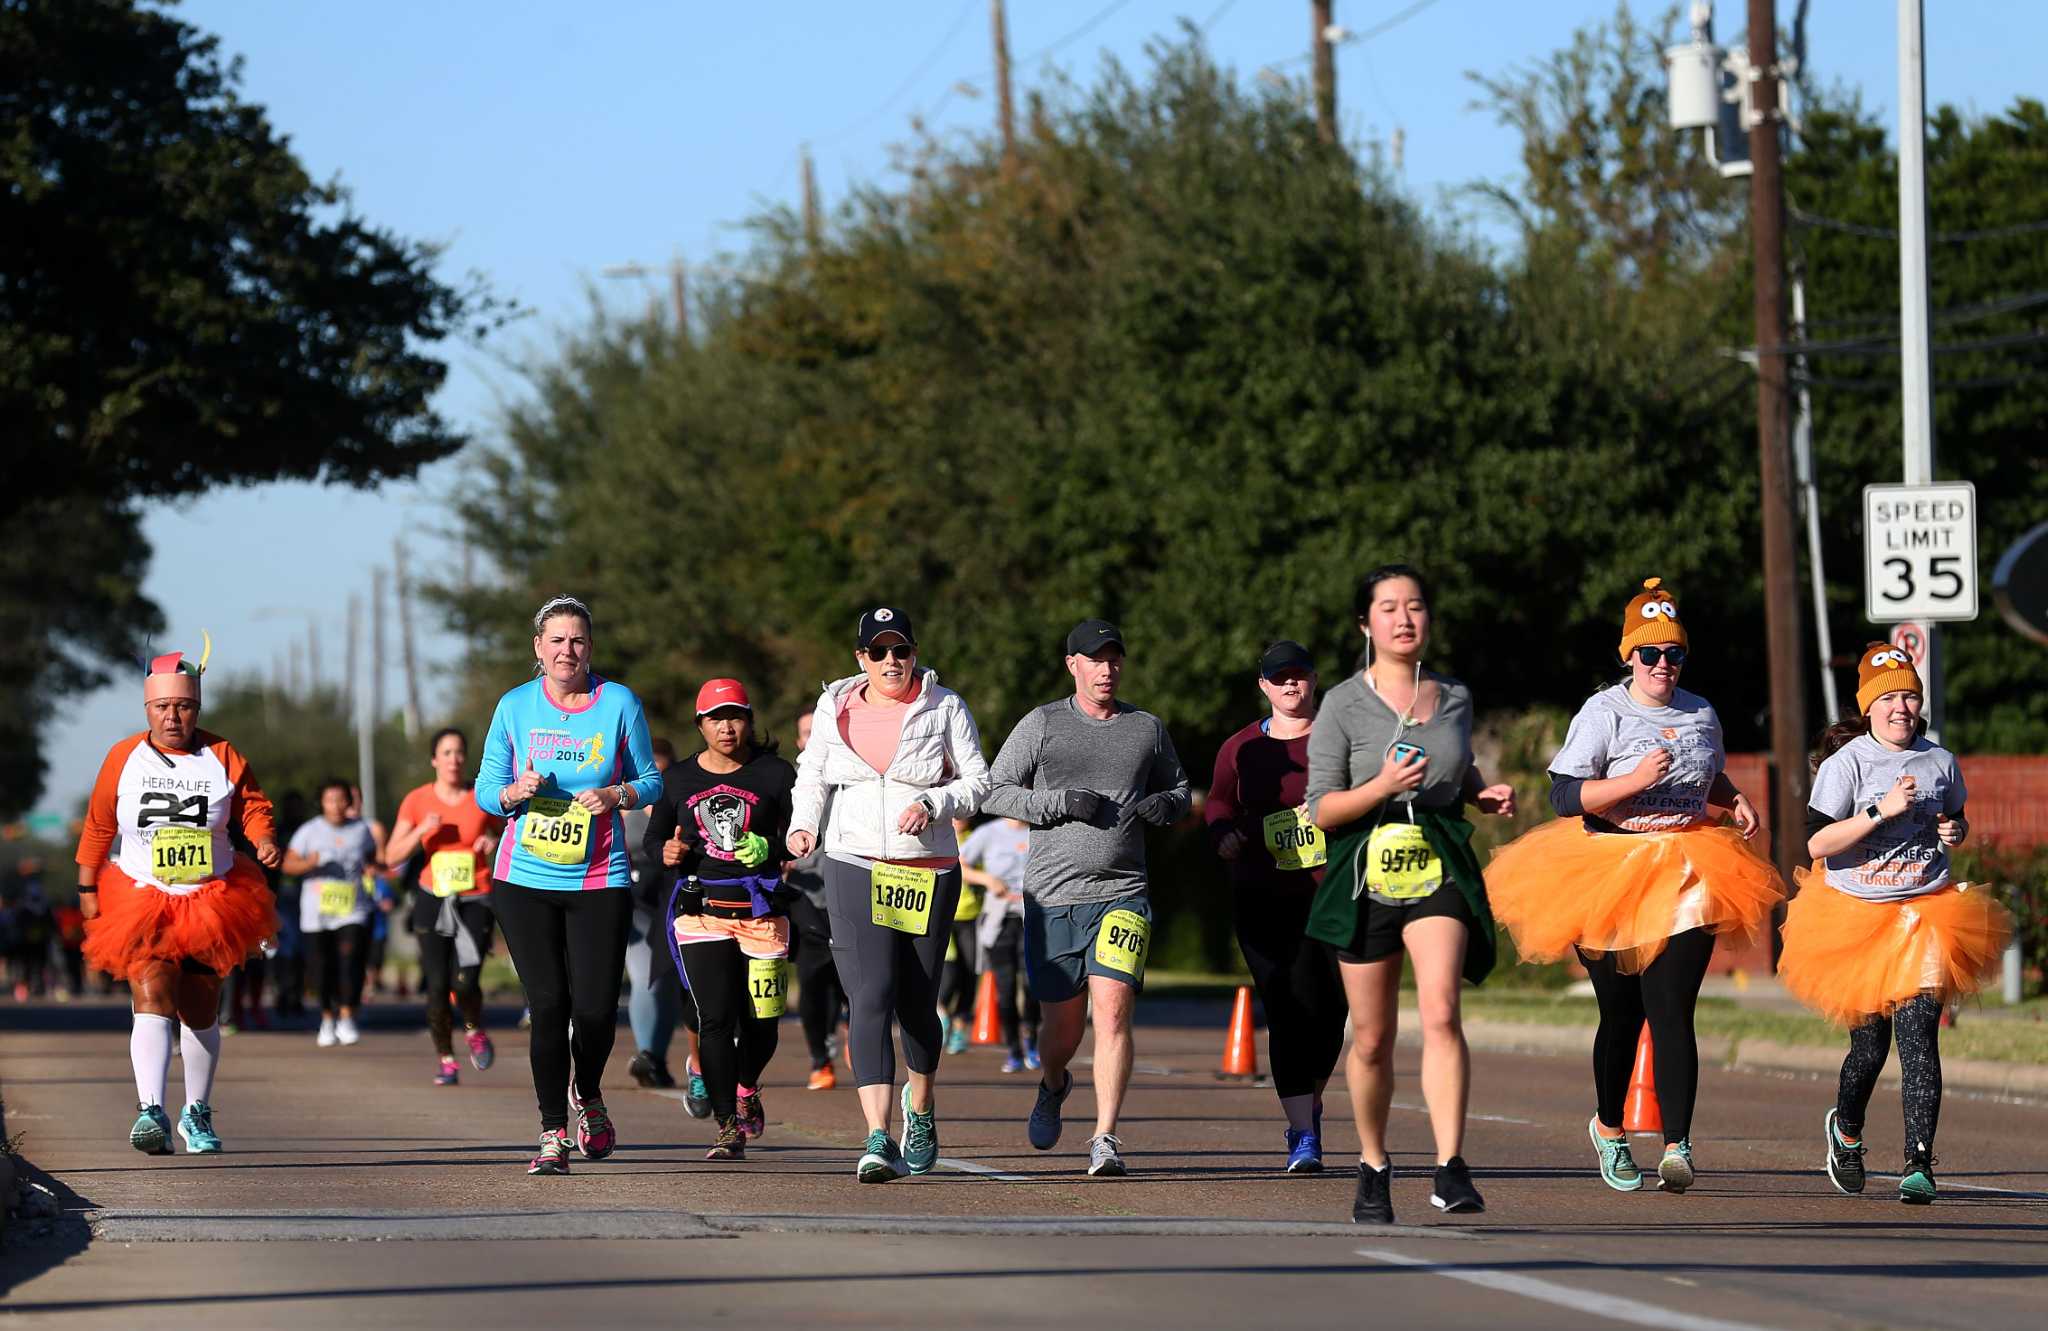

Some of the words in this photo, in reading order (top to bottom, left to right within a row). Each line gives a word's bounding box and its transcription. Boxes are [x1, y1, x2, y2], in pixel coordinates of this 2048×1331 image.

[1876, 500, 1964, 523] SPEED
[1886, 528, 1955, 549] LIMIT
[1881, 555, 1964, 601] 35
[529, 733, 583, 751] Turkey
[528, 746, 555, 760] Trot
[556, 750, 585, 762] 2015
[142, 776, 212, 793] HERBALIFE
[137, 792, 208, 828] 24
[528, 818, 584, 846] 12695
[1274, 825, 1315, 850] 9706
[156, 844, 207, 867] 10471
[1381, 847, 1430, 873] 9570
[1859, 872, 1906, 887] TURKEY
[875, 884, 927, 913] 13800
